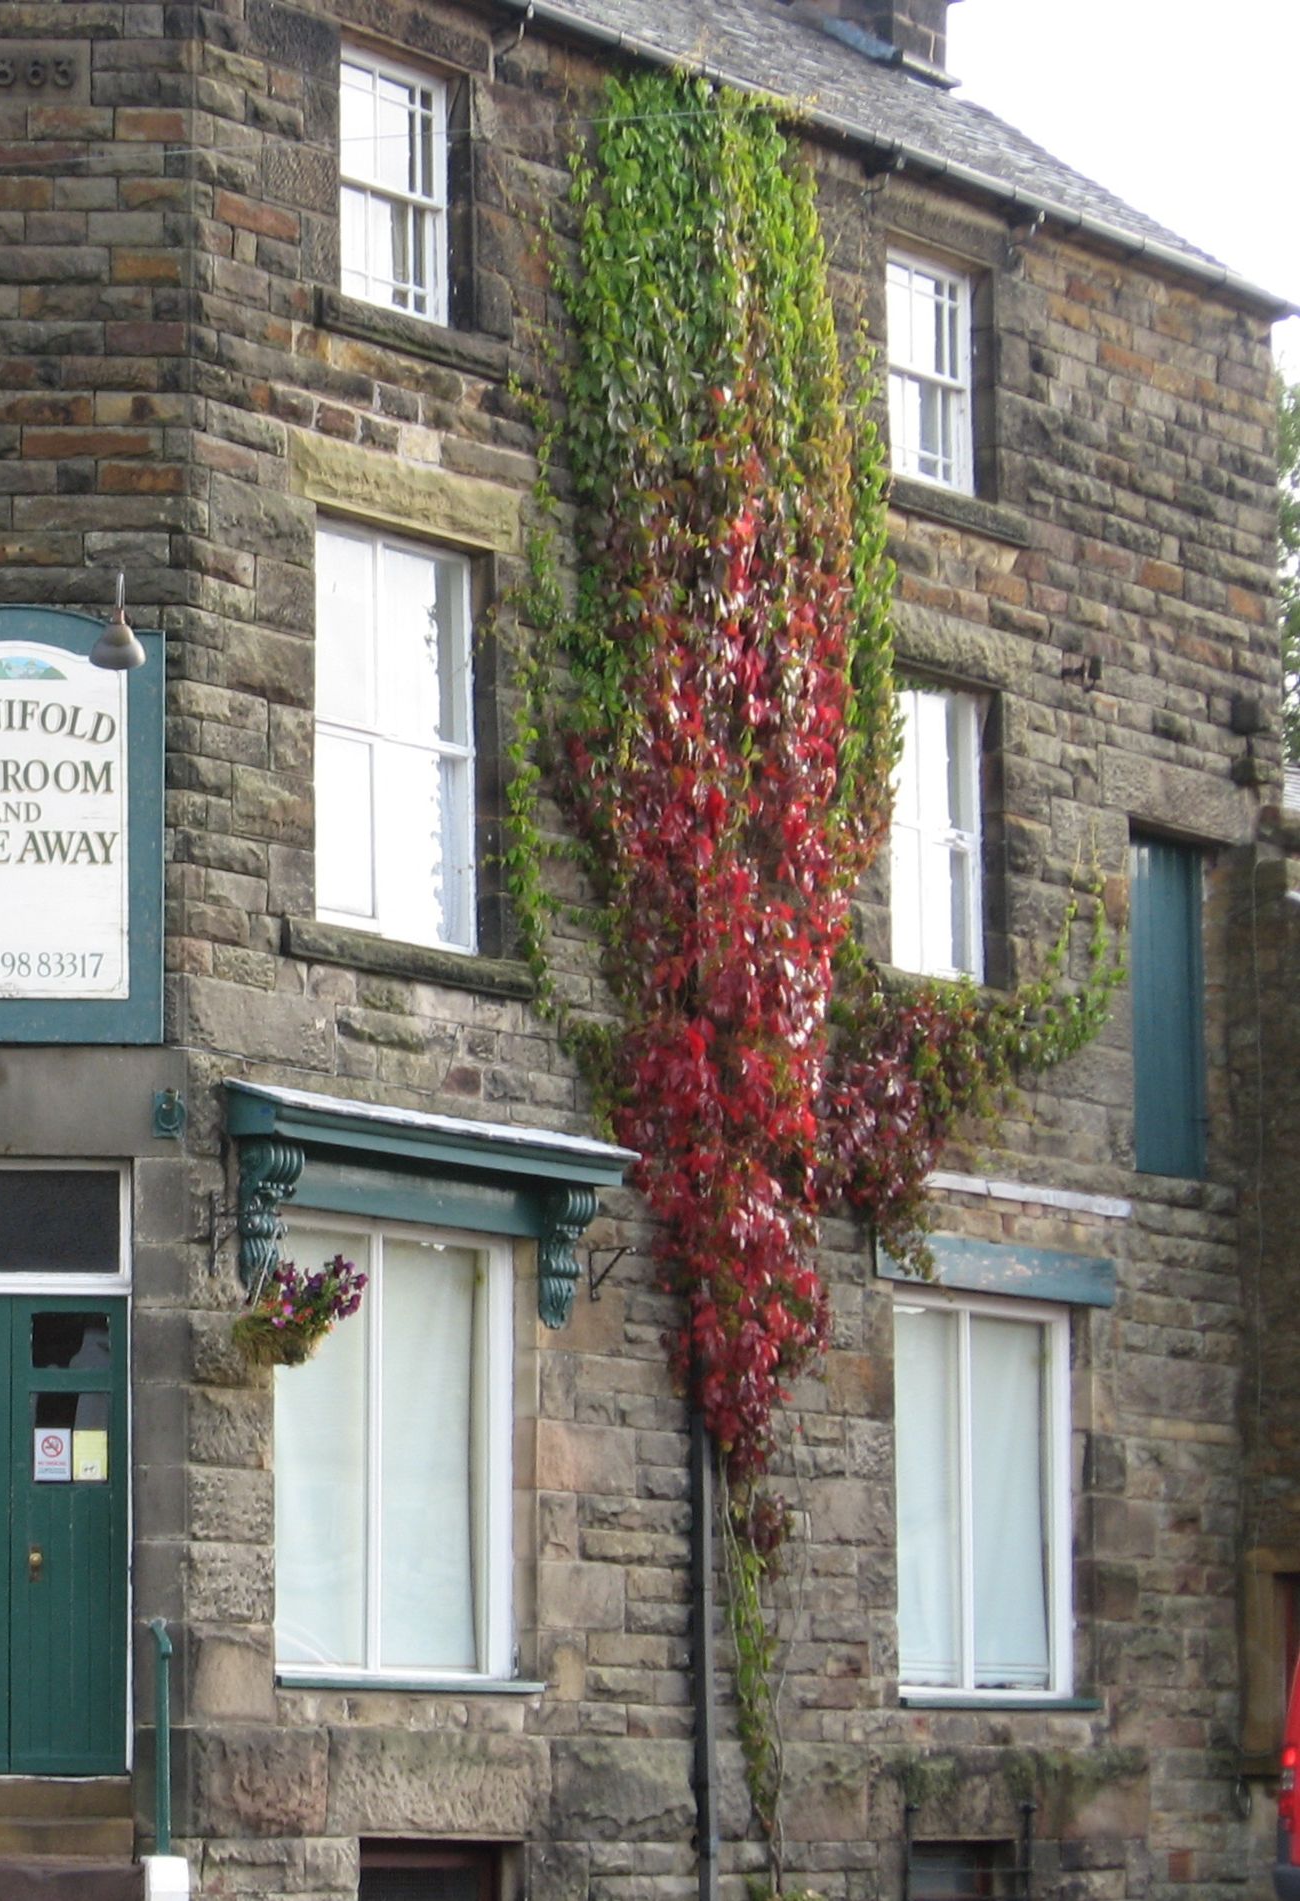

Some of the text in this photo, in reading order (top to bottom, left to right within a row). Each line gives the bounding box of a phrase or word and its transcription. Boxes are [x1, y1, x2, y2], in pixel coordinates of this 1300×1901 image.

[0, 759, 114, 794] ROOM
[15, 831, 119, 865] AWAY
[37, 952, 104, 978] 83317
